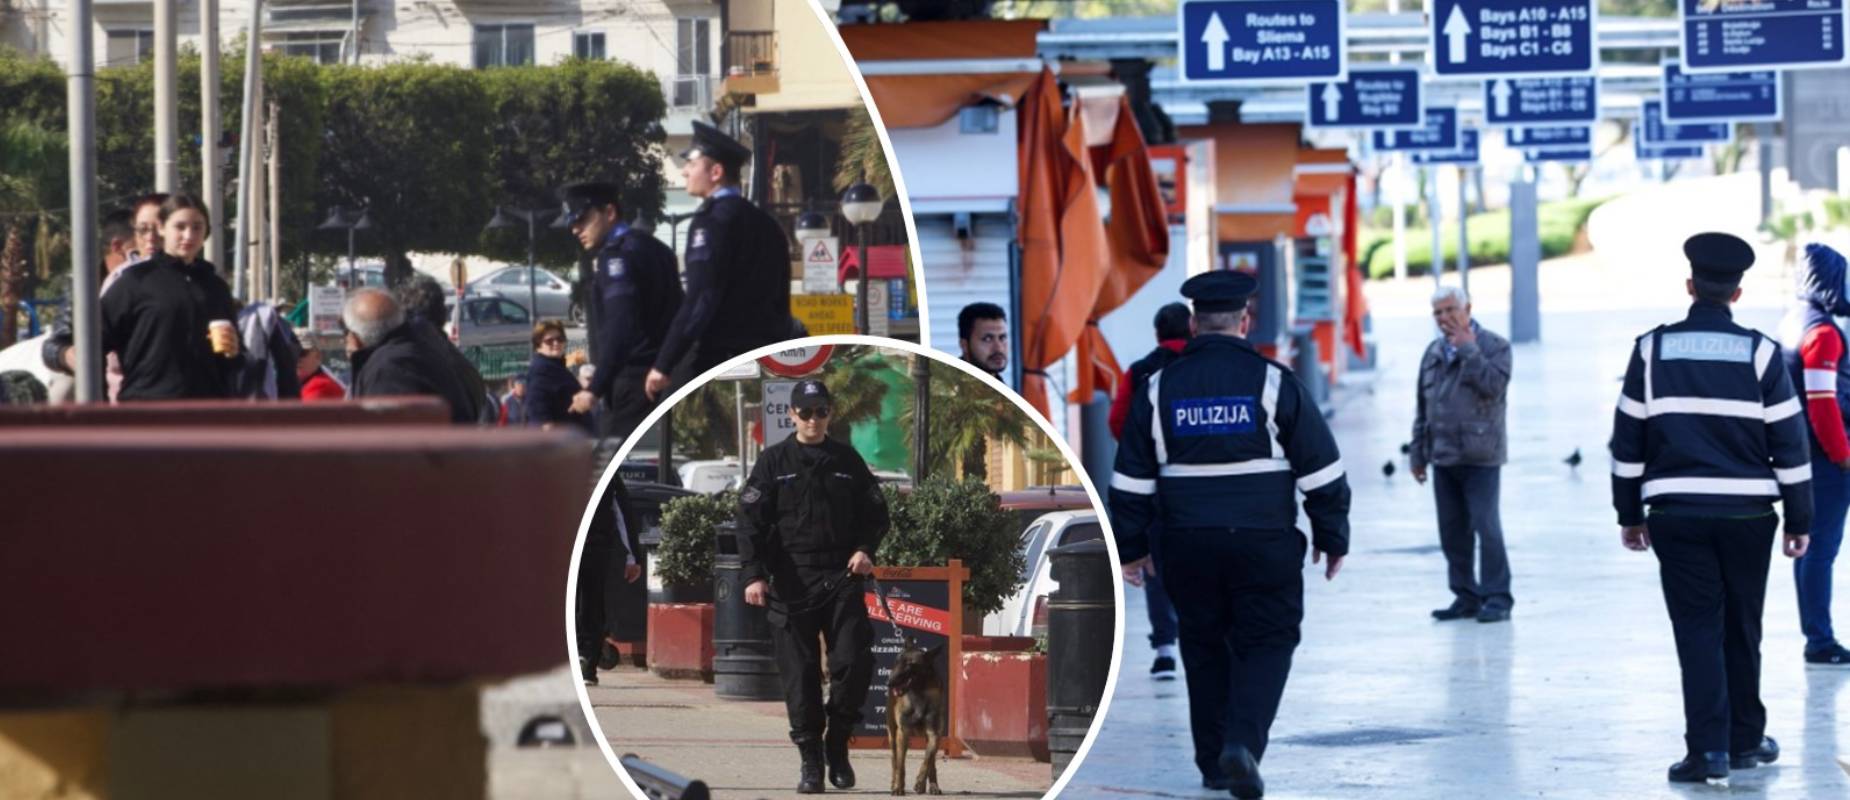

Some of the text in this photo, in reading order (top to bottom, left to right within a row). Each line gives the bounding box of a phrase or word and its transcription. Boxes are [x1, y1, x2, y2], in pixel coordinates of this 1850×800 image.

[1246, 12, 1315, 27] Routes to
[1481, 8, 1516, 25] Bays
[1519, 7, 1547, 21] A10
[1558, 6, 1586, 21] A15
[1257, 29, 1305, 44] Sliema
[1481, 25, 1516, 42] Bays
[1520, 24, 1538, 39] B1
[1232, 47, 1260, 64] Bay
[1262, 46, 1291, 60] A13
[1302, 45, 1330, 60] A15
[1481, 42, 1517, 59] Bays
[1520, 41, 1538, 56] C1
[1664, 337, 1747, 355] PULIZIJA
[1176, 404, 1251, 427] PULIZIJA
[897, 603, 925, 617] ARE
